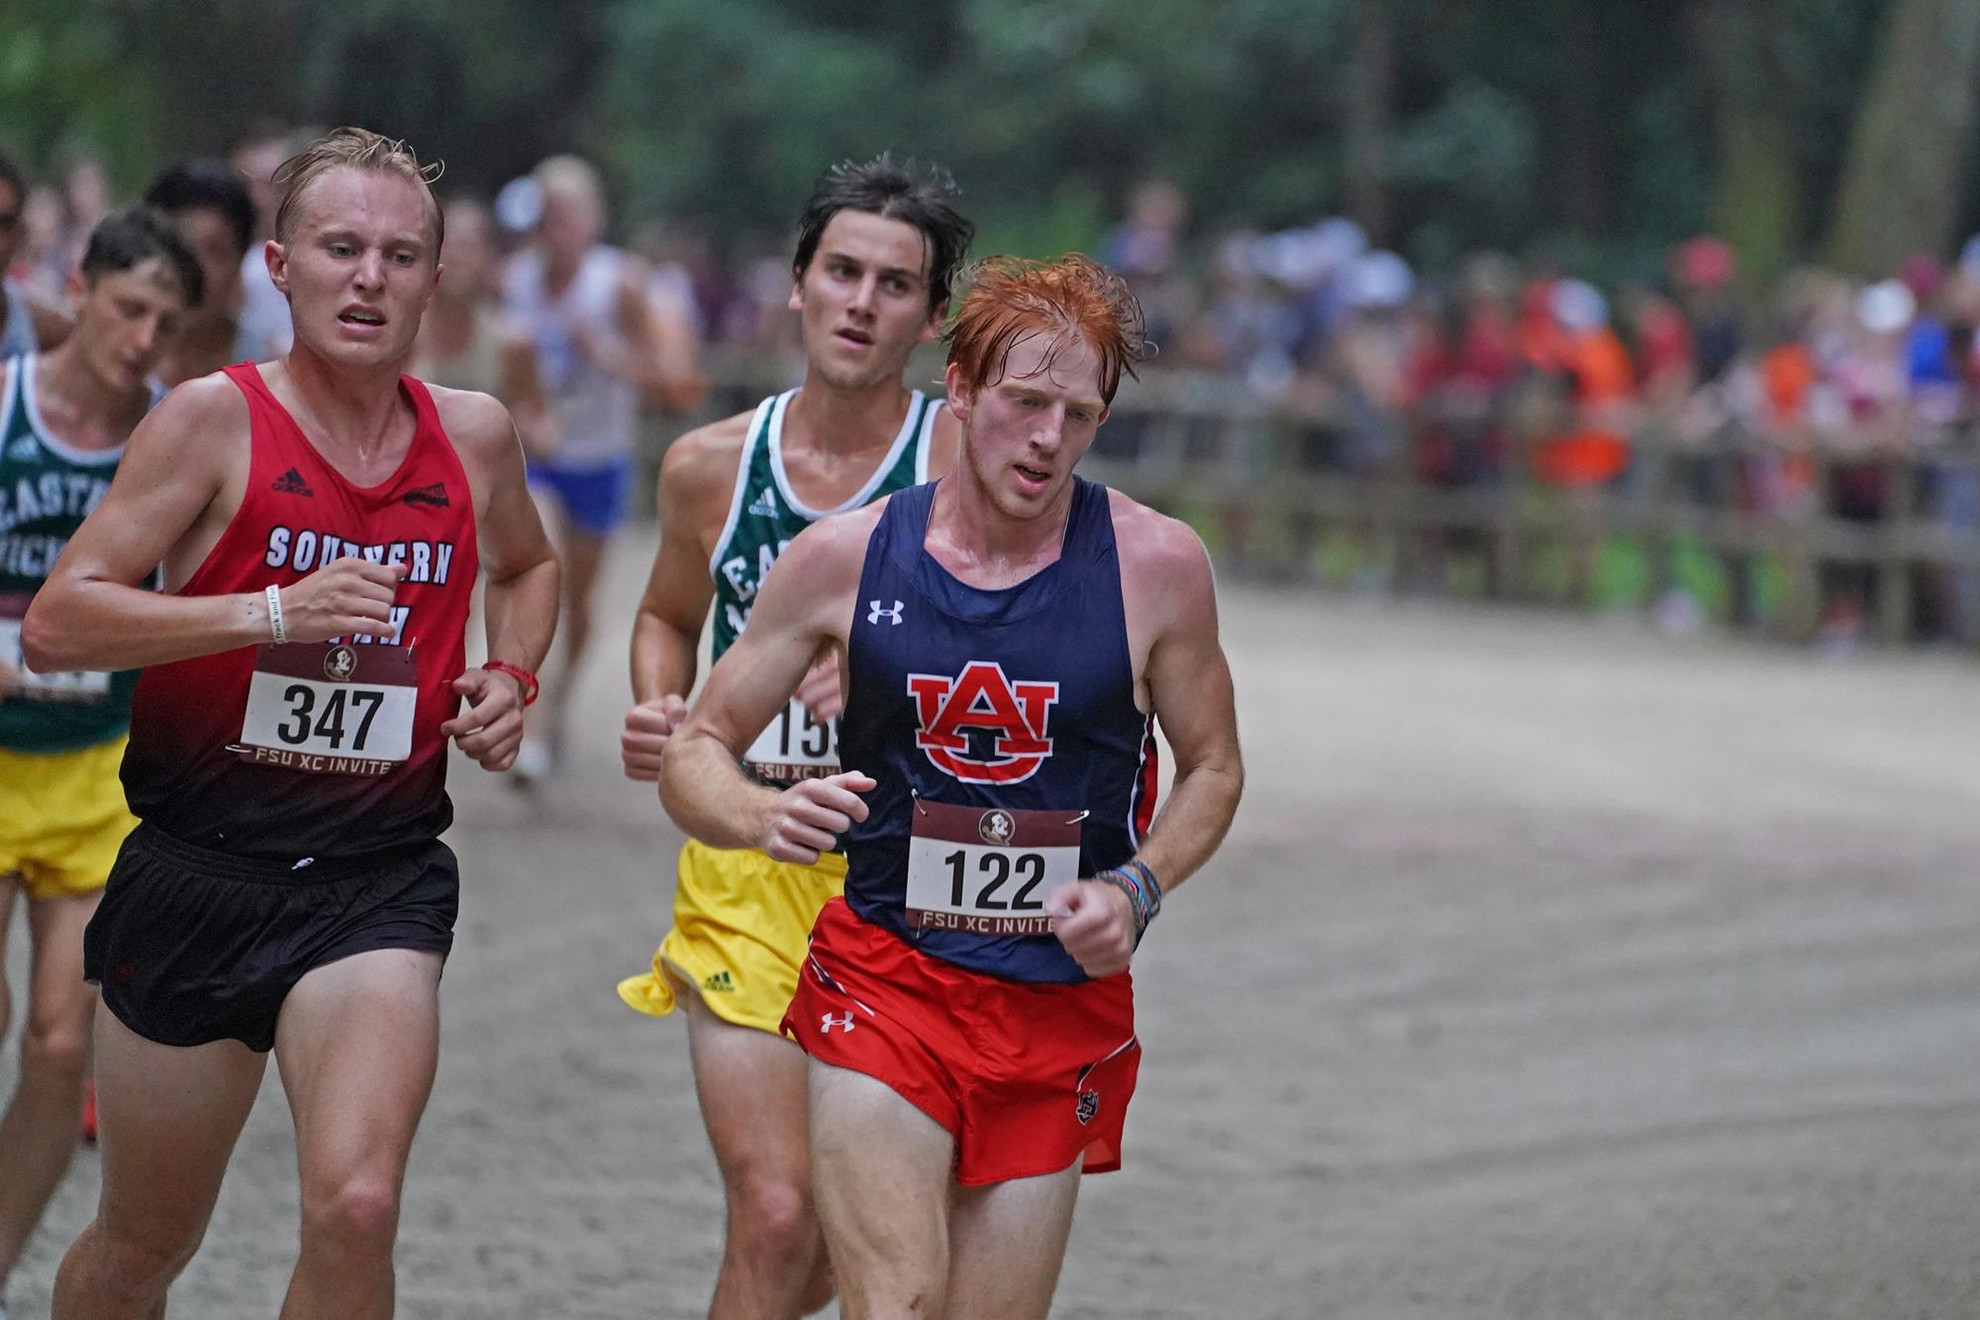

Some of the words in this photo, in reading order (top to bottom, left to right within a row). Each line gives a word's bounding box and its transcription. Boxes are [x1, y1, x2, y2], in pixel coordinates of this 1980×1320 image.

[277, 684, 385, 751] 347
[255, 748, 293, 765] FSU
[299, 754, 324, 770] XC
[329, 758, 391, 774] INVITE
[755, 763, 786, 779] FSU
[792, 765, 813, 779] XC
[945, 850, 1046, 910] 122
[922, 911, 959, 928] FSU
[965, 916, 990, 932] XC
